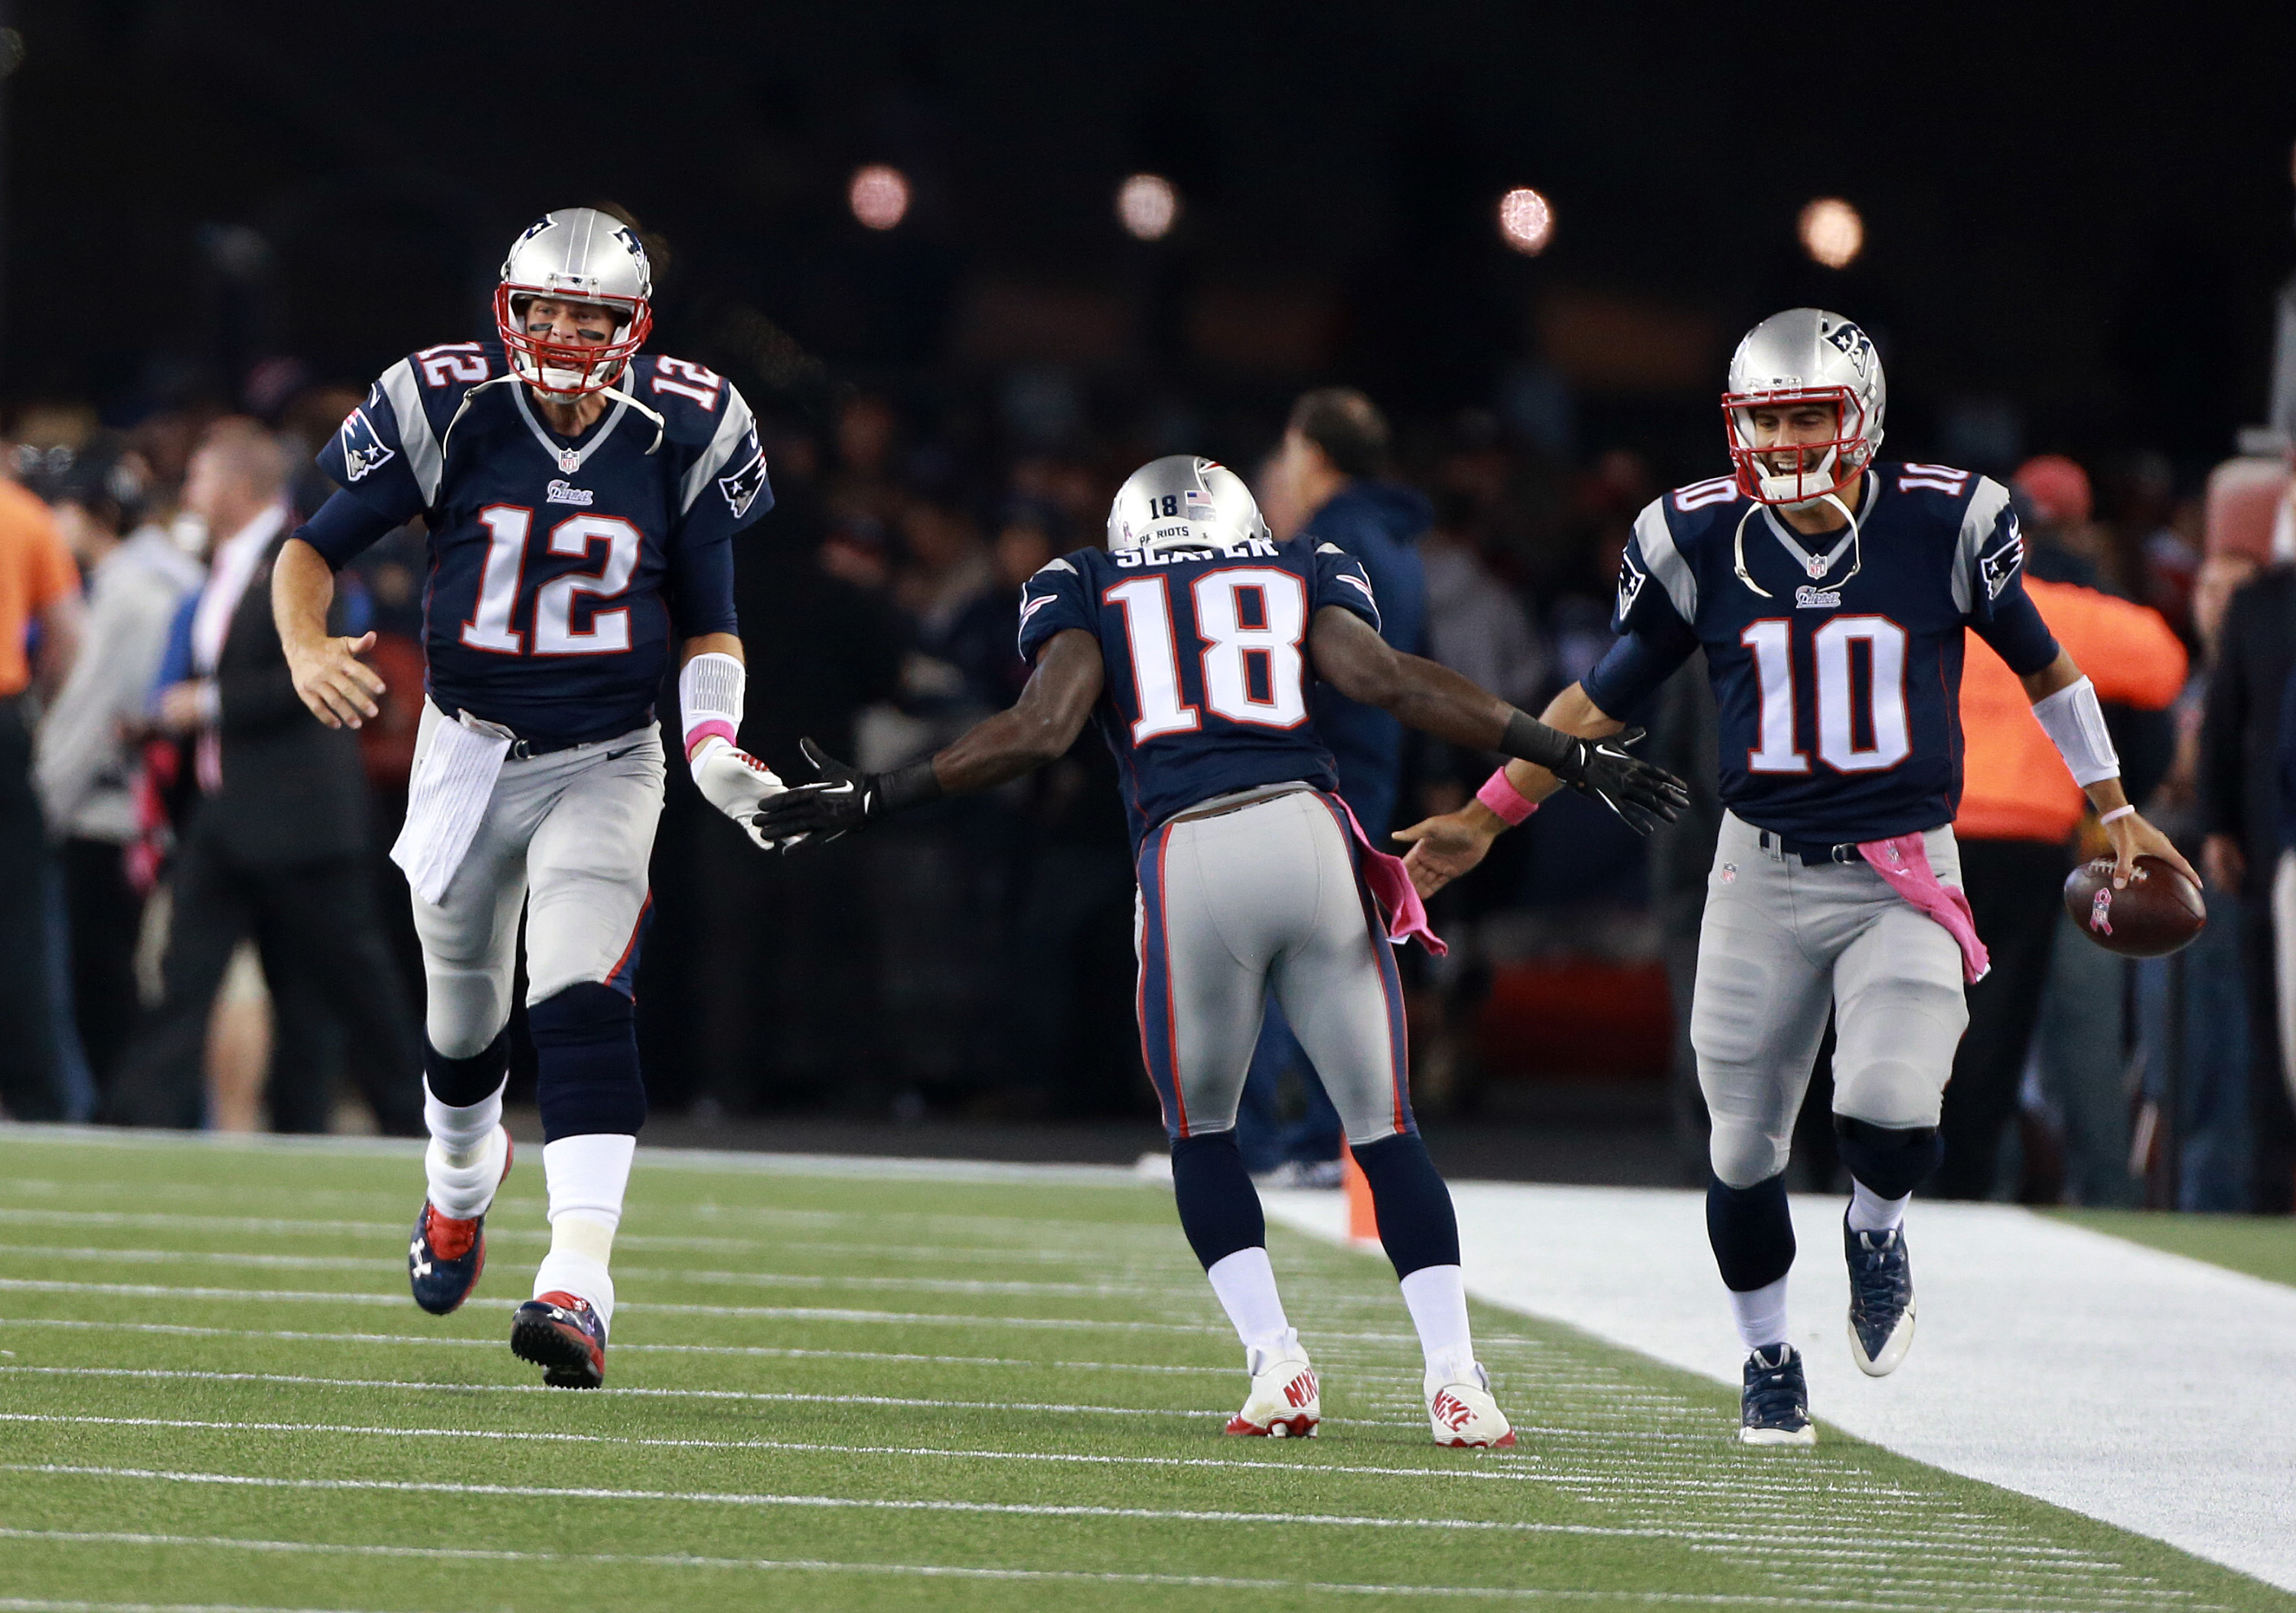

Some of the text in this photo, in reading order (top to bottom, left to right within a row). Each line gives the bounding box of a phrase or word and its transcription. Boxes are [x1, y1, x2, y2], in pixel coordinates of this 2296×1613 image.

[416, 340, 492, 388] 12
[651, 354, 722, 413] 12
[1149, 494, 1179, 520] 18
[1139, 525, 1190, 547] PARIOTS
[459, 502, 642, 656] 12
[1102, 566, 1309, 749] 18
[1741, 614, 1913, 775] 10
[1432, 1388, 1479, 1433] NIKE
